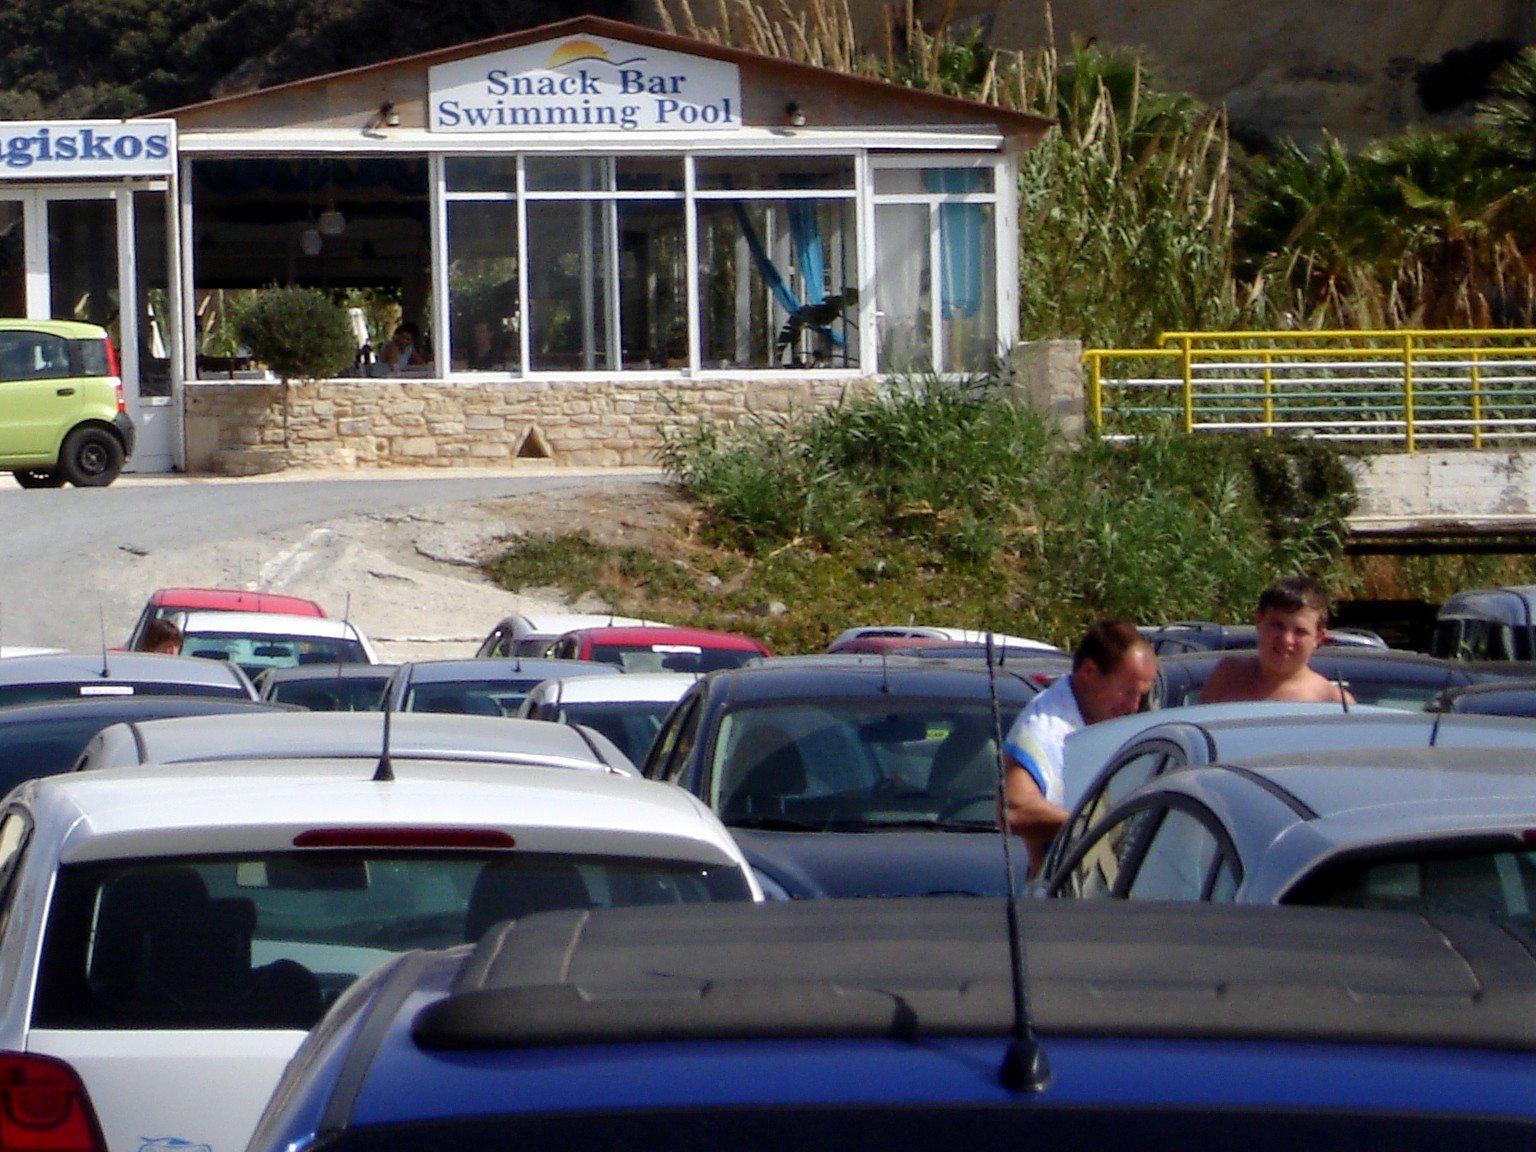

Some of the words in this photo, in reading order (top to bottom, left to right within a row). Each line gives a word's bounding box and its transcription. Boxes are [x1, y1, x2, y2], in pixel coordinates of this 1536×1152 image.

[486, 69, 601, 96] Snack
[618, 69, 687, 96] Bar
[438, 99, 640, 130] Swimming
[655, 98, 734, 124] Pool
